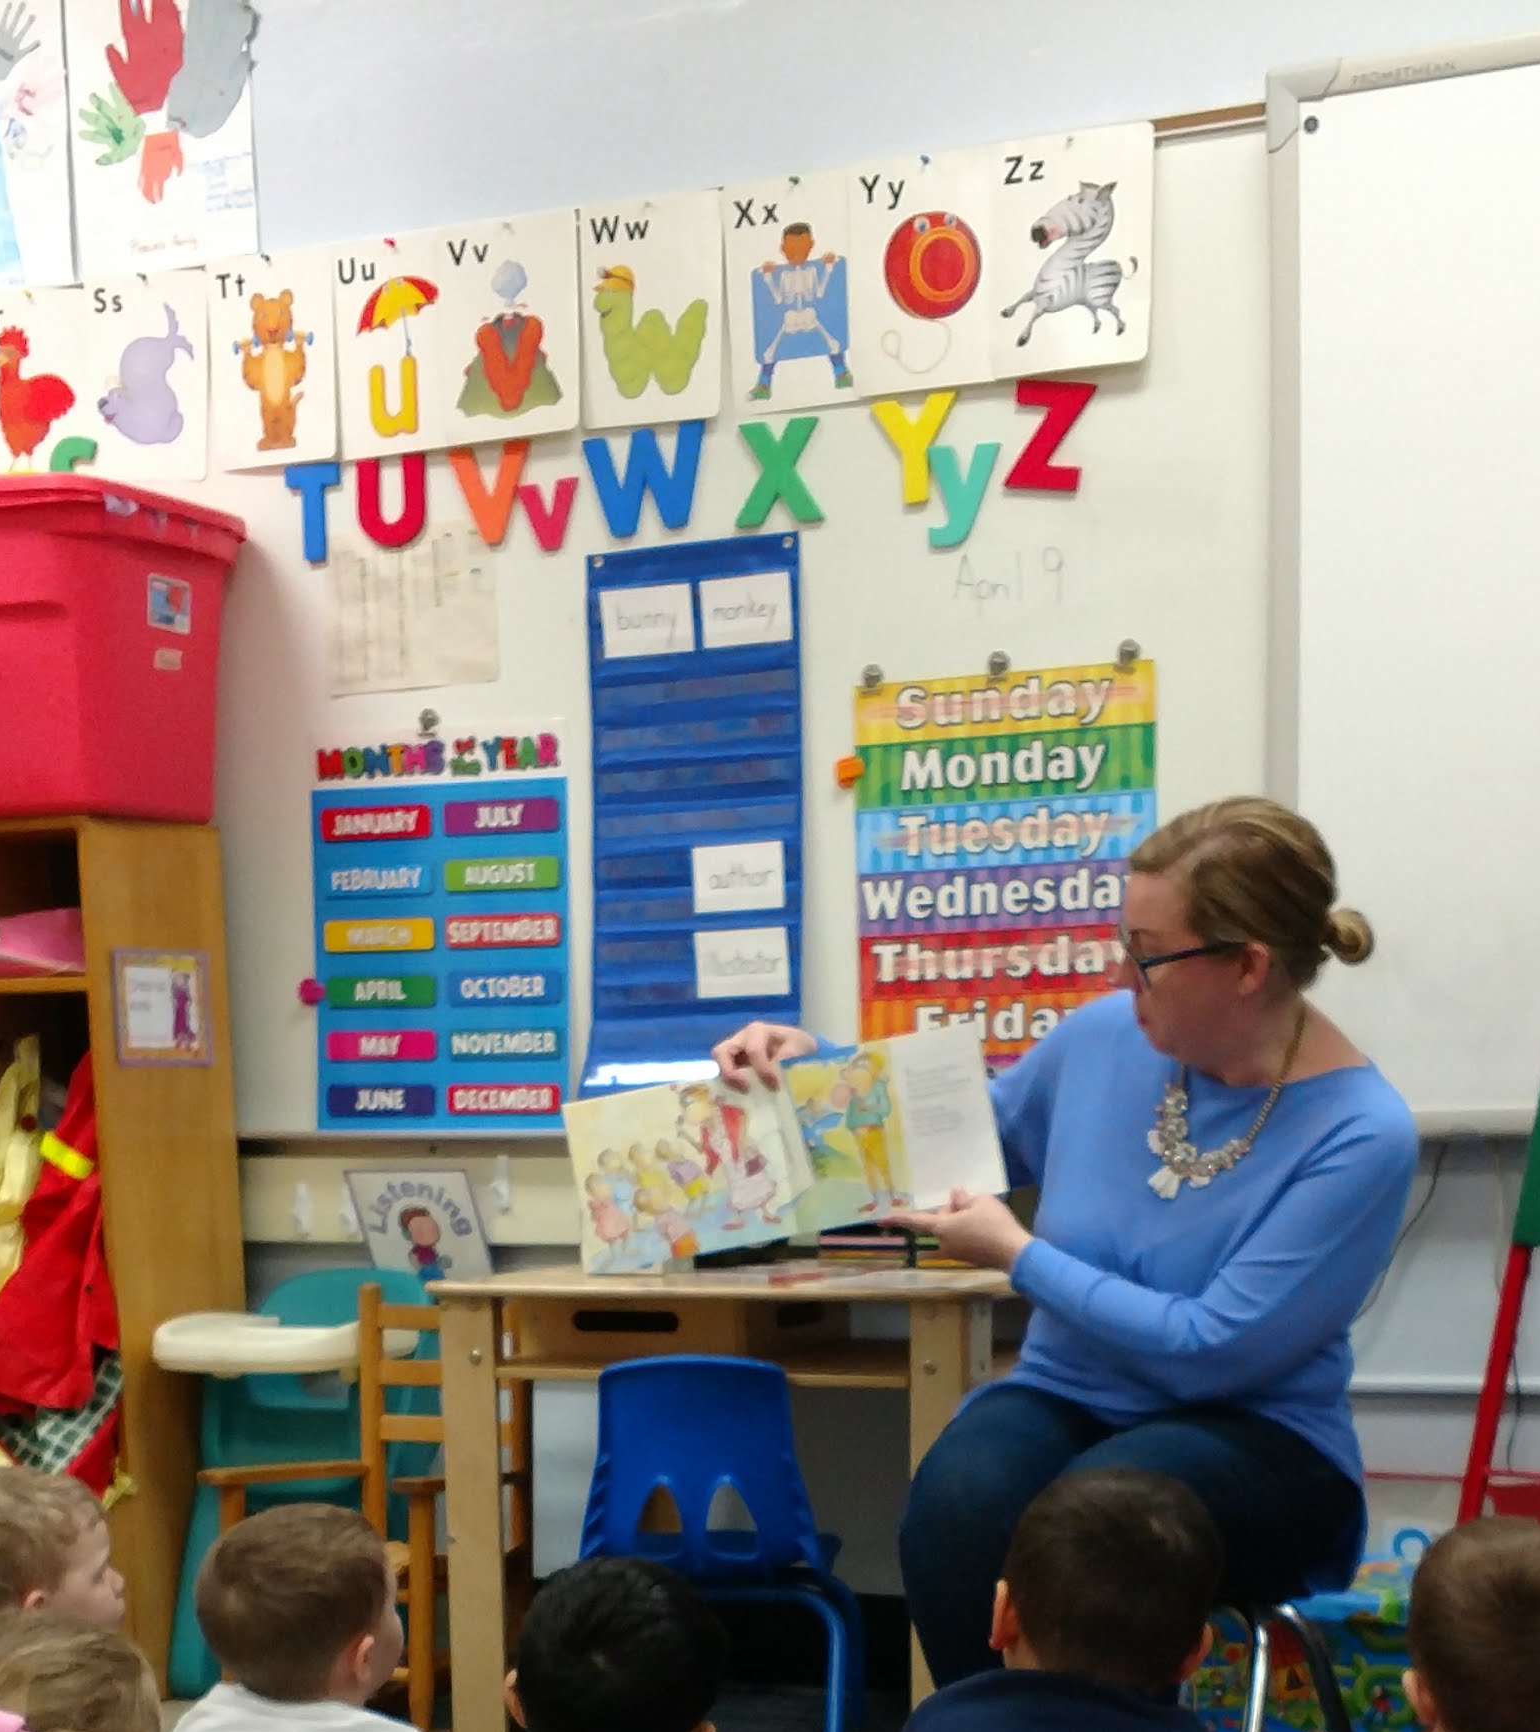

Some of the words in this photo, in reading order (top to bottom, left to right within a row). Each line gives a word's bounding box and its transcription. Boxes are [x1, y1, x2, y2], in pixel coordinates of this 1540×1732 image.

[216, 273, 247, 299] Tt
[338, 256, 377, 285] Uu
[447, 239, 489, 267] Vv
[590, 216, 651, 243] Ww
[733, 200, 780, 229] Xx
[860, 175, 906, 212] Yy
[1003, 155, 1045, 185] Zz
[94, 289, 123, 314] Ss
[284, 463, 340, 564] T
[356, 453, 426, 547] U
[582, 420, 706, 537] W
[734, 417, 825, 528] X
[1003, 380, 1096, 491] Z
[1042, 546, 1066, 603] 9
[615, 601, 678, 649] bunny
[712, 592, 778, 632] monkey
[895, 675, 1113, 729] Sunday
[317, 739, 446, 781] MONTHS
[481, 733, 559, 771] YEAR
[900, 740, 1106, 791] Monday
[331, 809, 419, 836] JANUARY
[475, 804, 525, 828] JULY
[898, 806, 1110, 858] Tuesday
[331, 866, 422, 891] FEBRUARY
[465, 862, 537, 886] AUGUST
[709, 863, 776, 890] author
[862, 868, 1130, 920] Wednesda
[448, 918, 558, 944] SEPTEMBER
[354, 979, 407, 1002] APRIL
[460, 975, 546, 999] OCTOBER
[359, 1034, 402, 1057] MAY
[451, 1030, 557, 1055] NOVEMBER
[354, 1088, 406, 1112] JUNE
[452, 1088, 553, 1111] DECEMBER
[367, 1180, 473, 1237] Listening
